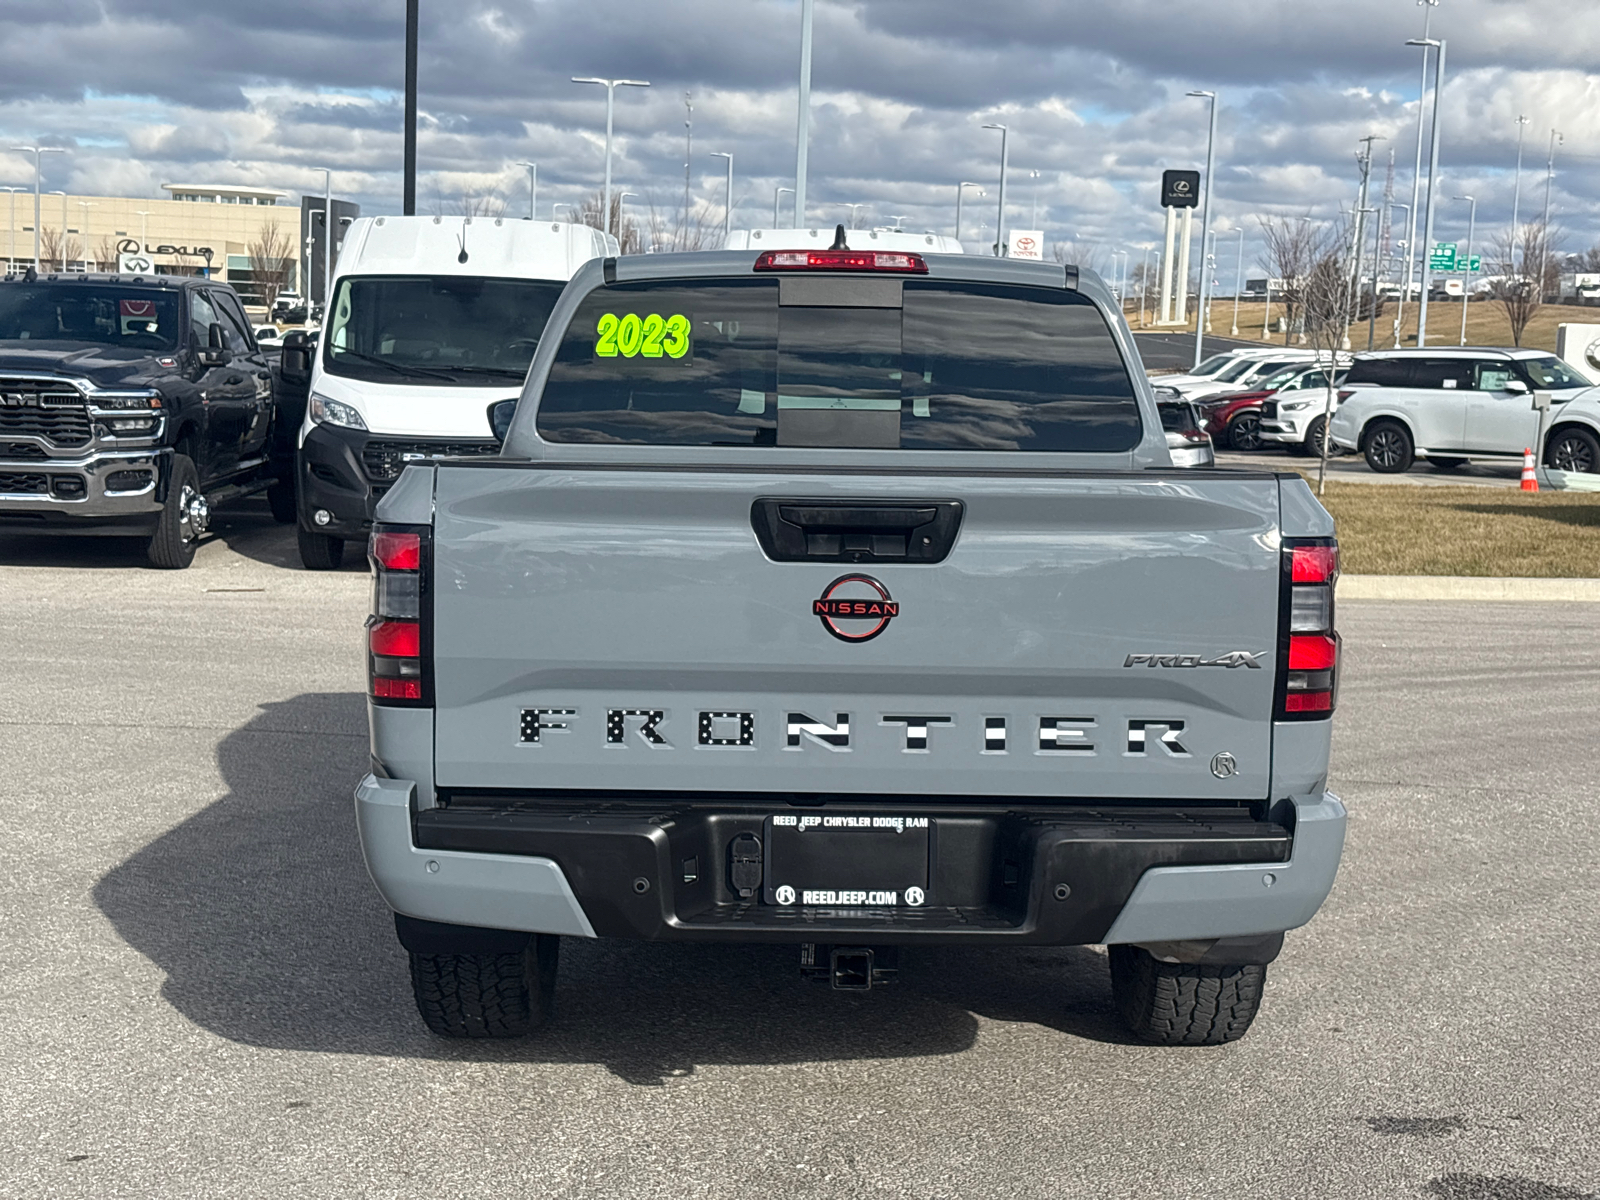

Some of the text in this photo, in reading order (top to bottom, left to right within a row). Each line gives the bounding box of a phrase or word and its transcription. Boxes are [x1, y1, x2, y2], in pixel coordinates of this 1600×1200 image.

[145, 244, 212, 256] LEXUS
[1013, 250, 1038, 258] TOYOTA
[595, 312, 691, 359] 2023
[815, 601, 897, 615] NISSAN
[1123, 651, 1268, 669] PRO-4X
[516, 706, 1192, 758] FRONTIER
[773, 815, 929, 828] REED JEEP CHRYSLER DODGE RAM
[803, 891, 897, 905] REEDJEEP.COM
